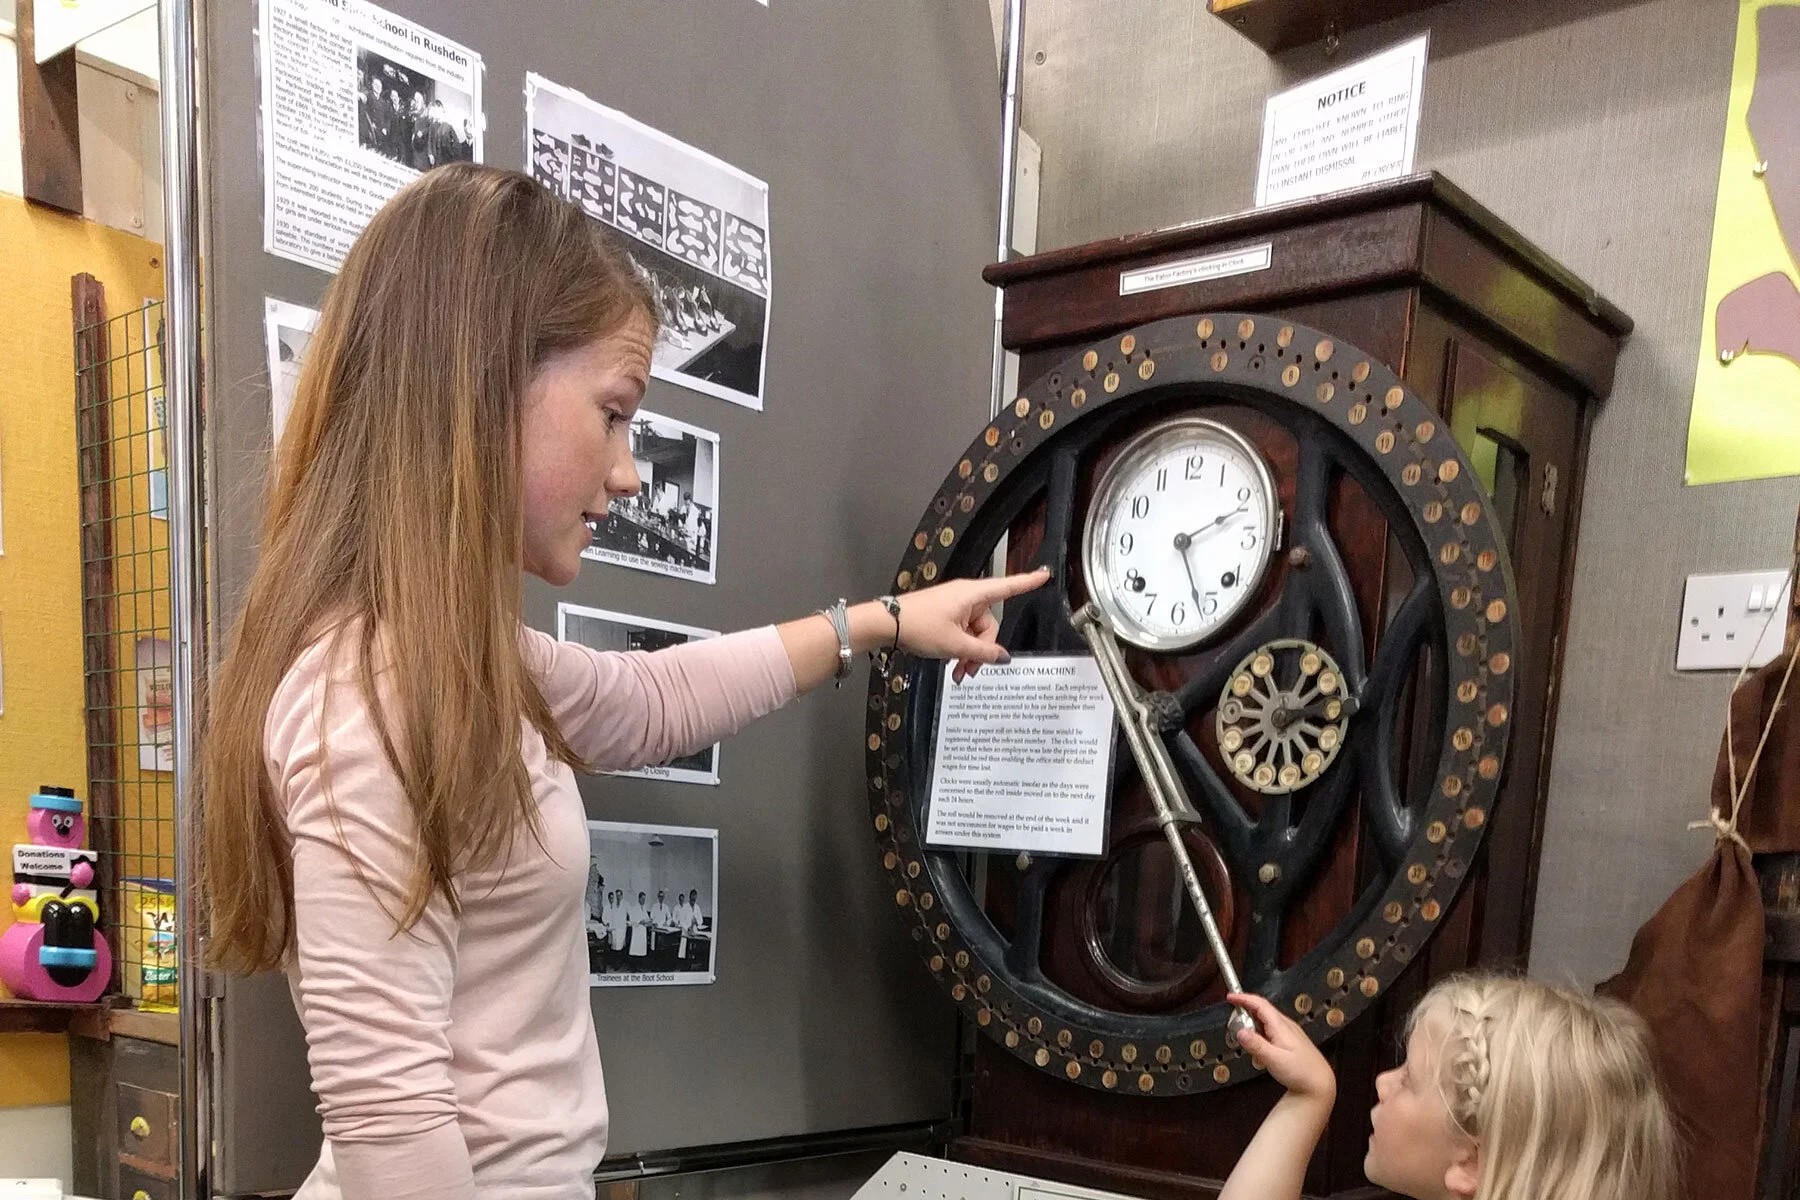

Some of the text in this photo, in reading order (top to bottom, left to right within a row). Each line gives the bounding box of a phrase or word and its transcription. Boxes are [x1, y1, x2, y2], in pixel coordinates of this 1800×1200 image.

[411, 31, 420, 45] in
[424, 38, 467, 67] Rushden
[1317, 81, 1366, 111] NOTICE
[1184, 455, 1204, 480] 12
[1219, 463, 1226, 487] 1
[1156, 468, 1168, 492] 11
[1131, 495, 1150, 519] 10
[1236, 487, 1251, 513] 2
[1119, 532, 1134, 556] 9
[1240, 526, 1257, 550] 3
[595, 547, 620, 560] Learning
[640, 557, 650, 566] the
[651, 561, 668, 571] sewing
[669, 565, 694, 576] machines
[1124, 567, 1140, 592] 8
[1144, 593, 1157, 616] 7
[1170, 601, 1185, 626] 6
[1202, 591, 1218, 616] 5
[980, 667, 1075, 676] CLOCKING ON MACHINE
[17, 850, 65, 858] Donations
[20, 862, 63, 870] Welcome
[598, 973, 621, 981] Trainees
[656, 973, 674, 981] School
